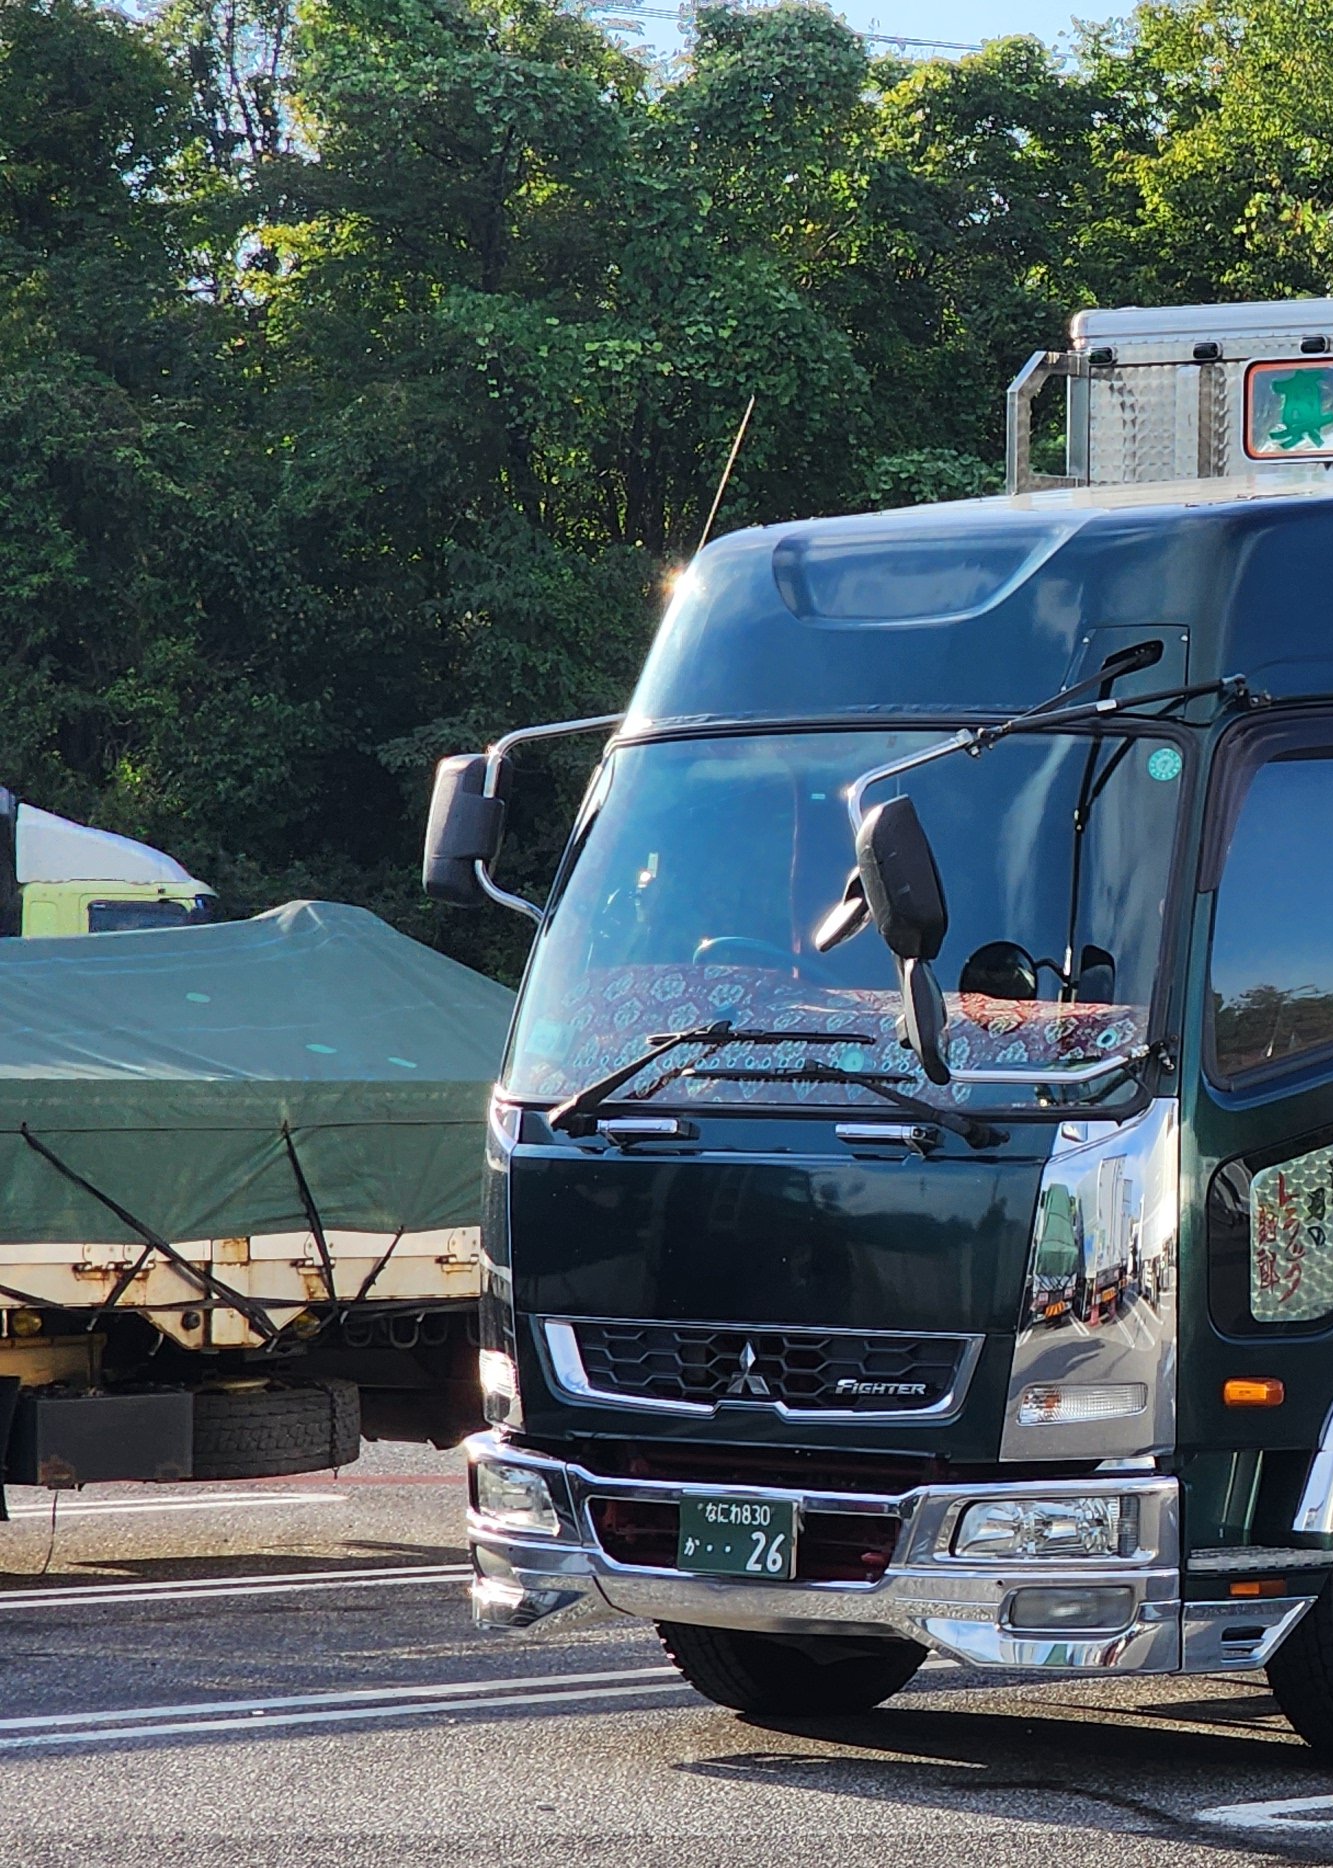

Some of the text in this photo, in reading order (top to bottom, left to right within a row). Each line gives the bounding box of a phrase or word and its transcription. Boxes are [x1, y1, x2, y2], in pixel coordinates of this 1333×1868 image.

[1278, 1172, 1306, 1303] トラック
[834, 1379, 927, 1395] FIGHTER
[745, 1531, 785, 1573] 26
